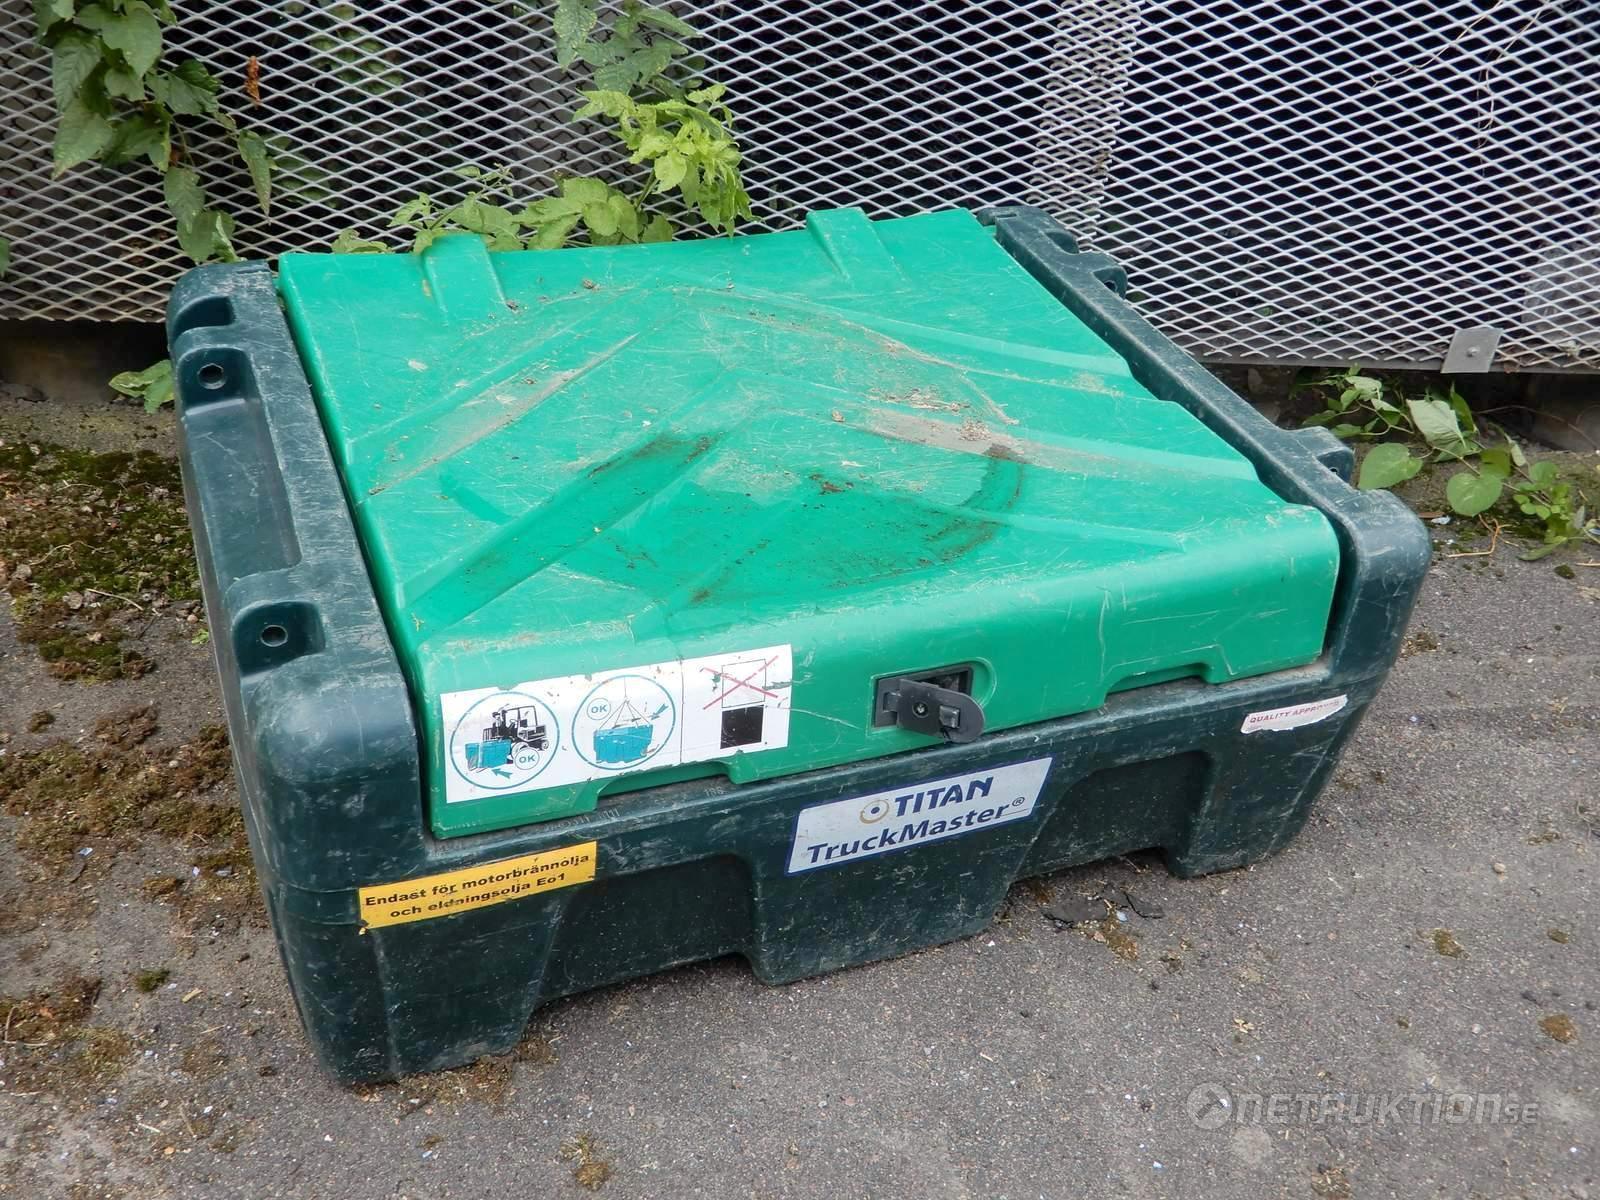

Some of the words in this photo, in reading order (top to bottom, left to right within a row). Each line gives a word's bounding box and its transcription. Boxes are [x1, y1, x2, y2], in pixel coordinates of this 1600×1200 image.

[590, 703, 608, 715] OK
[1249, 711, 1291, 723] QUALITY
[518, 753, 536, 764] OK
[894, 776, 994, 818] TITAN
[365, 888, 427, 906] Endast
[432, 883, 459, 896] för
[462, 854, 589, 890] motorbrännolja
[390, 906, 422, 918] och
[428, 882, 531, 911] eldningsolja
[536, 872, 566, 888] Eo1
